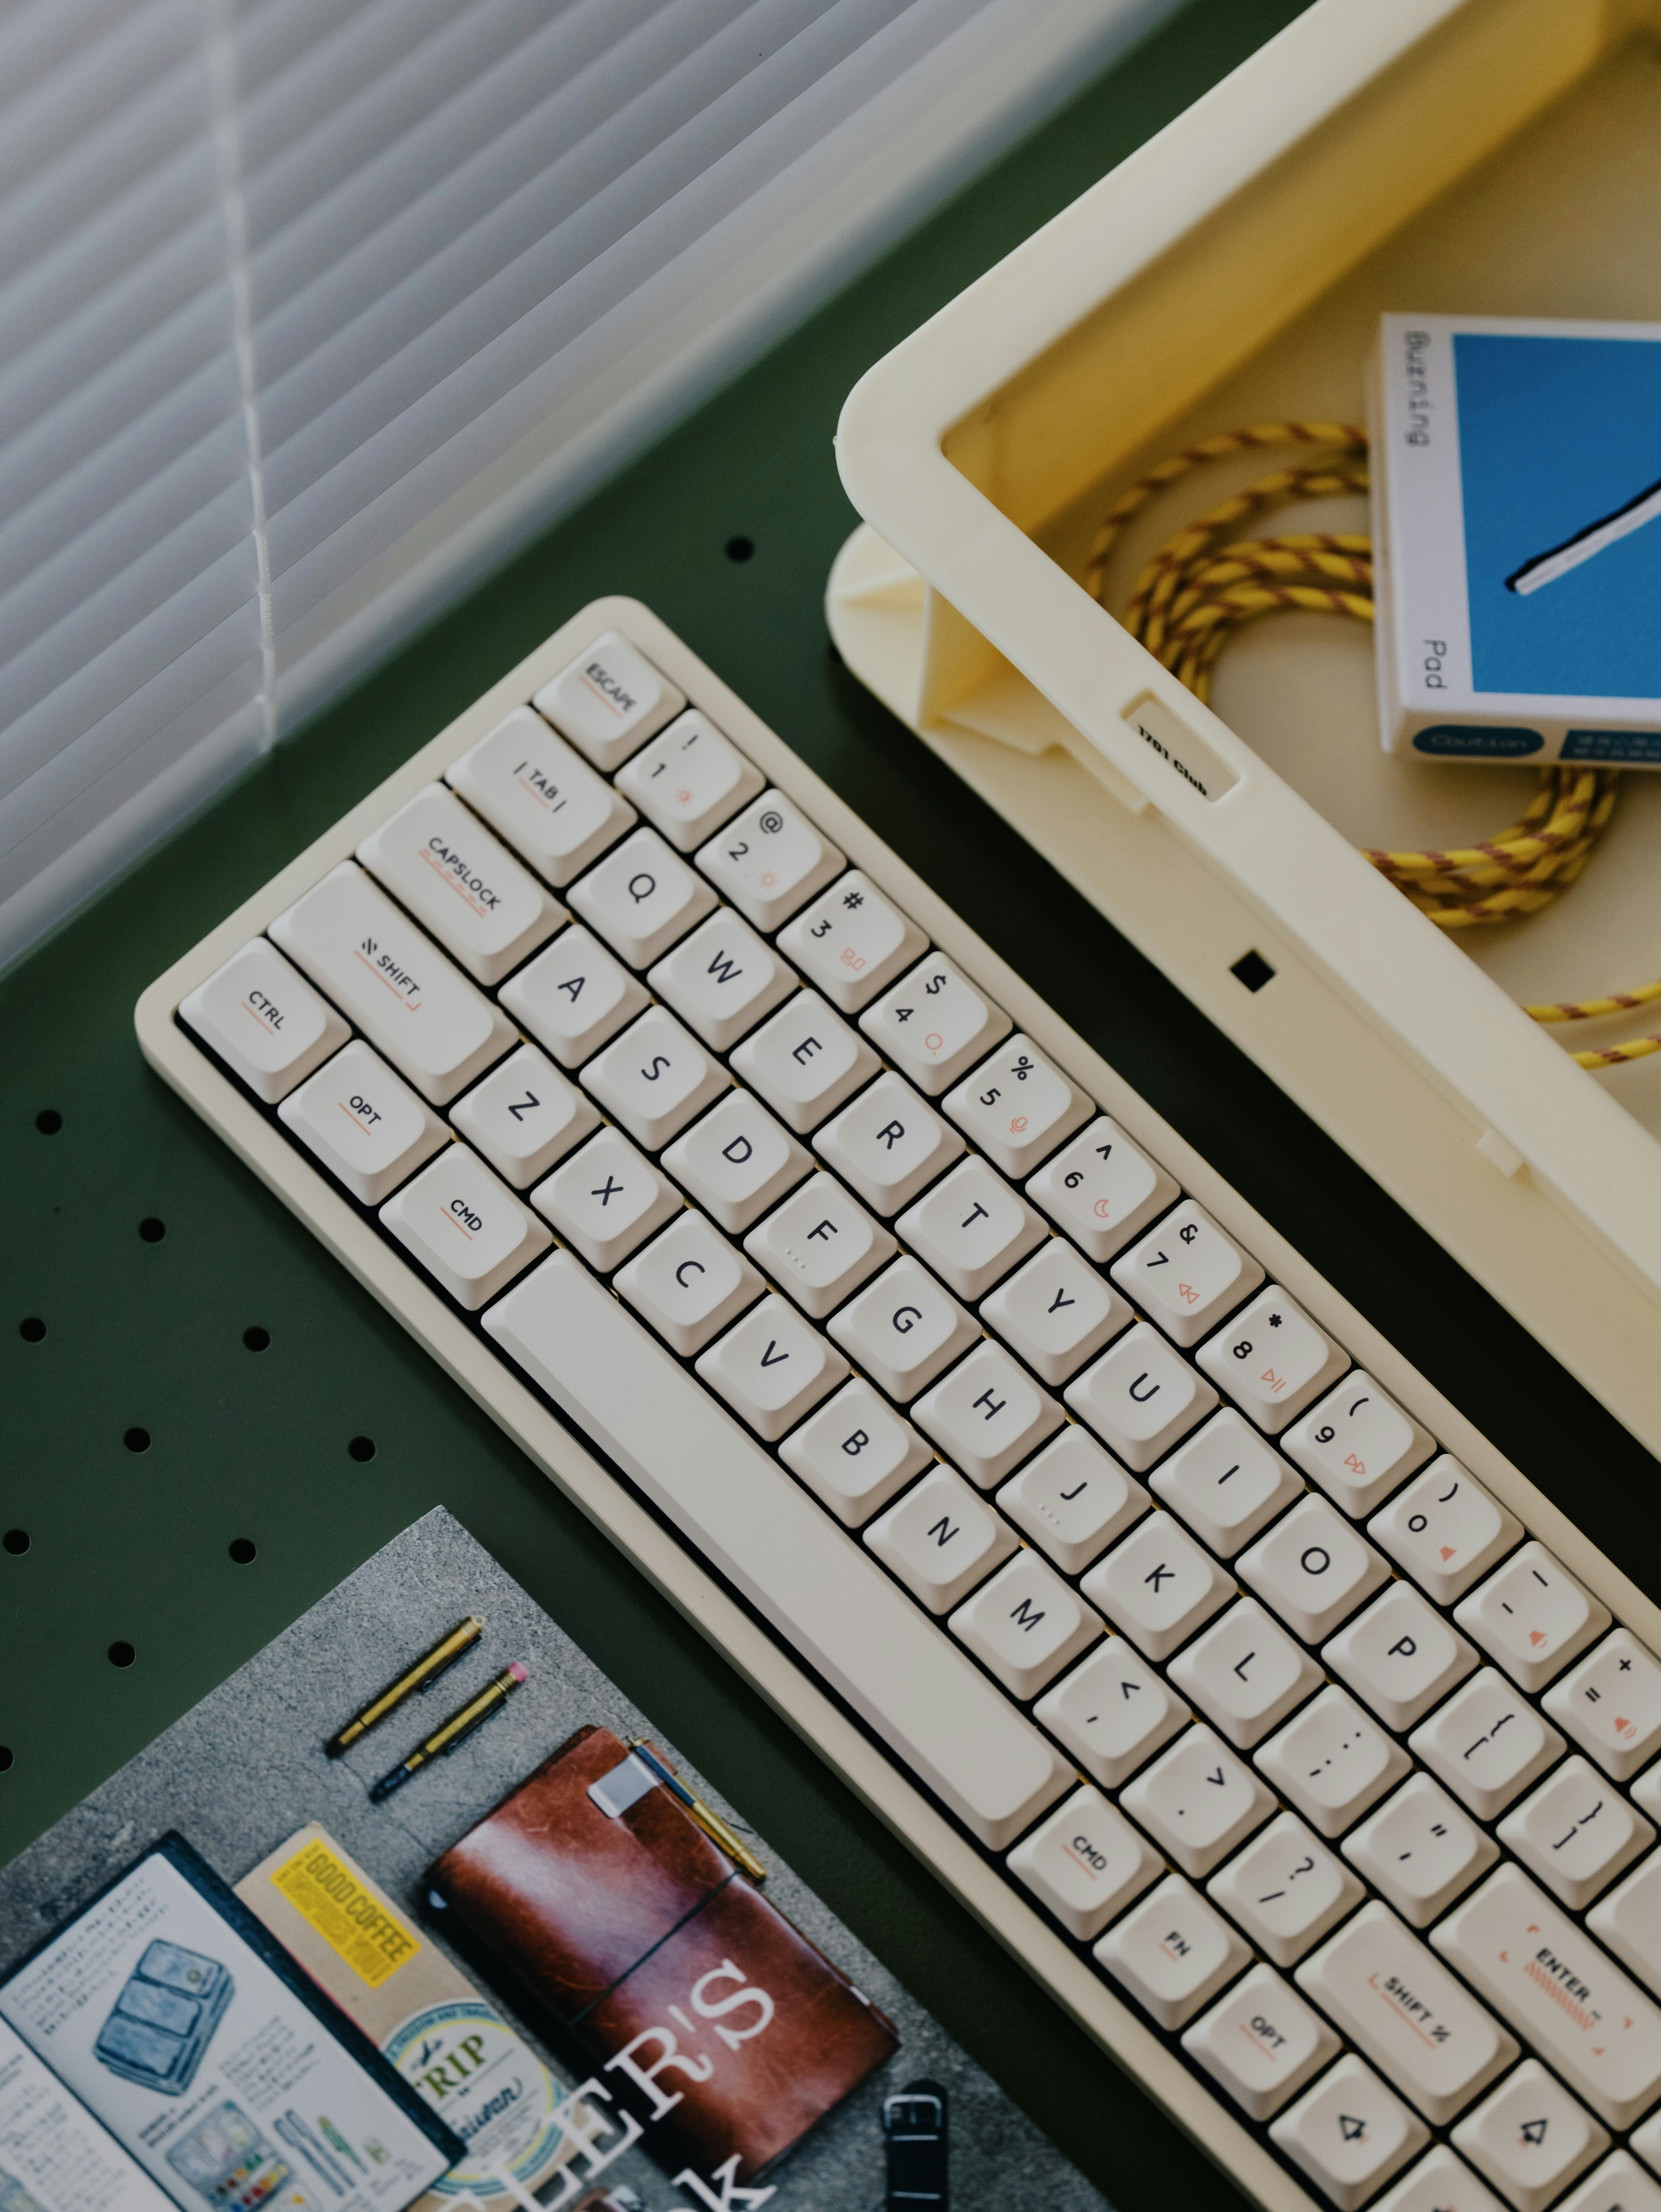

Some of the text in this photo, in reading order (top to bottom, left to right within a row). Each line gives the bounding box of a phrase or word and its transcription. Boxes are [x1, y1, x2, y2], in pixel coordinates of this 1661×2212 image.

[1404, 330, 1433, 448] Burning
[1423, 639, 1448, 690] Pad
[586, 663, 636, 711] ESCAPE
[652, 763, 666, 777] 1
[1173, 759, 1207, 796] Club
[529, 770, 559, 800] TAB
[729, 842, 748, 861] 2
[429, 837, 501, 909] CAPSLOCK
[628, 874, 656, 903] Q
[811, 920, 832, 937] 3
[377, 955, 420, 995] SHIFT
[708, 950, 742, 984] W
[558, 977, 586, 1003] A
[249, 991, 285, 1030] CTRL
[895, 1008, 914, 1022] 4
[792, 1037, 822, 1065] E
[641, 1056, 671, 1081] S
[350, 1096, 382, 1124] OPT
[508, 1091, 540, 1121] Z
[980, 1088, 1001, 1106] 5
[722, 1135, 752, 1164] D
[876, 1120, 905, 1150] R
[591, 1175, 624, 1206] X
[1064, 1172, 1084, 1189] 6
[451, 1199, 482, 1231] CMD
[962, 1202, 989, 1228] T
[807, 1220, 838, 1241] F
[1147, 1251, 1169, 1267] 7
[676, 1261, 705, 1288] C
[1048, 1288, 1075, 1314] Y
[892, 1306, 922, 1334] G
[760, 1340, 789, 1367] V
[1233, 1341, 1253, 1359] 8
[1129, 1373, 1160, 1402] U
[973, 1388, 1006, 1420] H
[841, 1429, 869, 1456] B
[1315, 1426, 1335, 1443] 9
[1218, 1465, 1240, 1485] I
[1060, 1482, 1088, 1500] J
[928, 1516, 959, 1546] N
[1408, 1515, 1428, 1532] 0
[1301, 1546, 1330, 1575] O
[1144, 1564, 1175, 1593] K
[1010, 1598, 1045, 1632] M
[1388, 1636, 1416, 1657] P
[1234, 1652, 1255, 1681] L
[1073, 1836, 1105, 1869] CMD
[305, 1853, 356, 1904] GOOD
[345, 1894, 413, 1963] COFFEE
[1166, 1931, 1190, 1956] FN
[1536, 1948, 1589, 2001] ENTER
[1386, 1977, 1431, 2021] SHIFT
[1251, 2016, 1286, 2048] OPT
